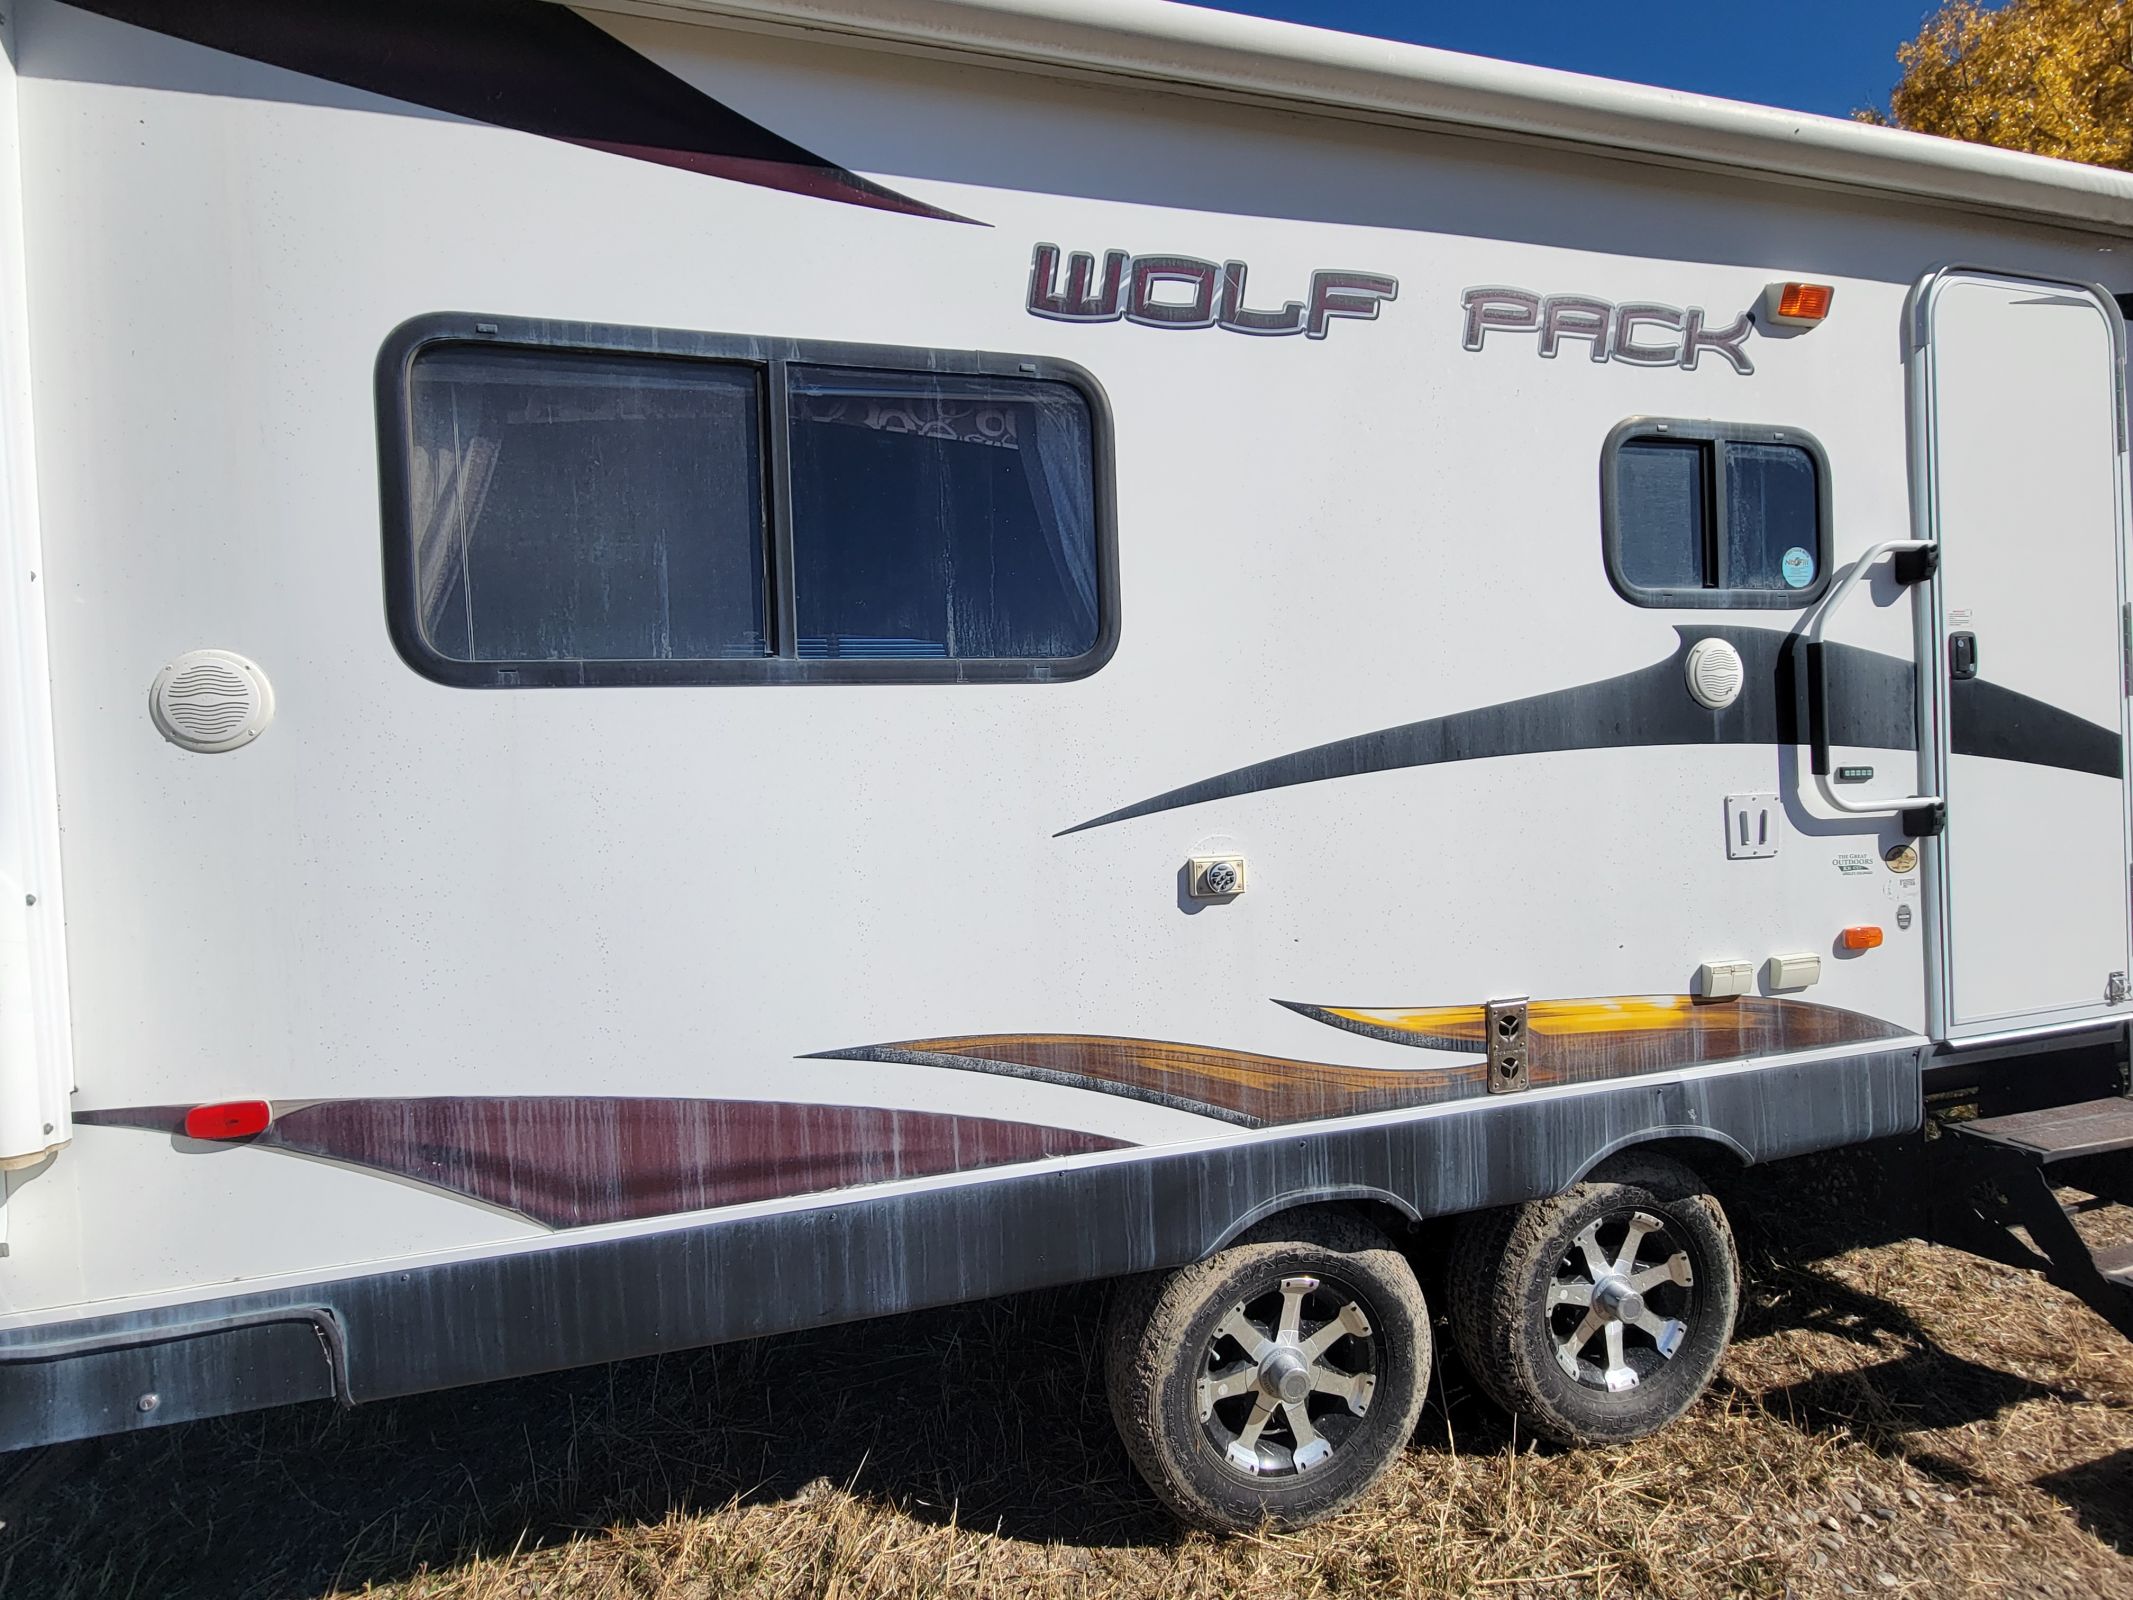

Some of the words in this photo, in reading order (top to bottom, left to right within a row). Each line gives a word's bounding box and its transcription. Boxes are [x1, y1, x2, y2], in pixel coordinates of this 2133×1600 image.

[1026, 241, 1399, 340] WOLF
[1461, 284, 1754, 376] PACK
[1200, 1252, 1363, 1322] TRIANGLE
